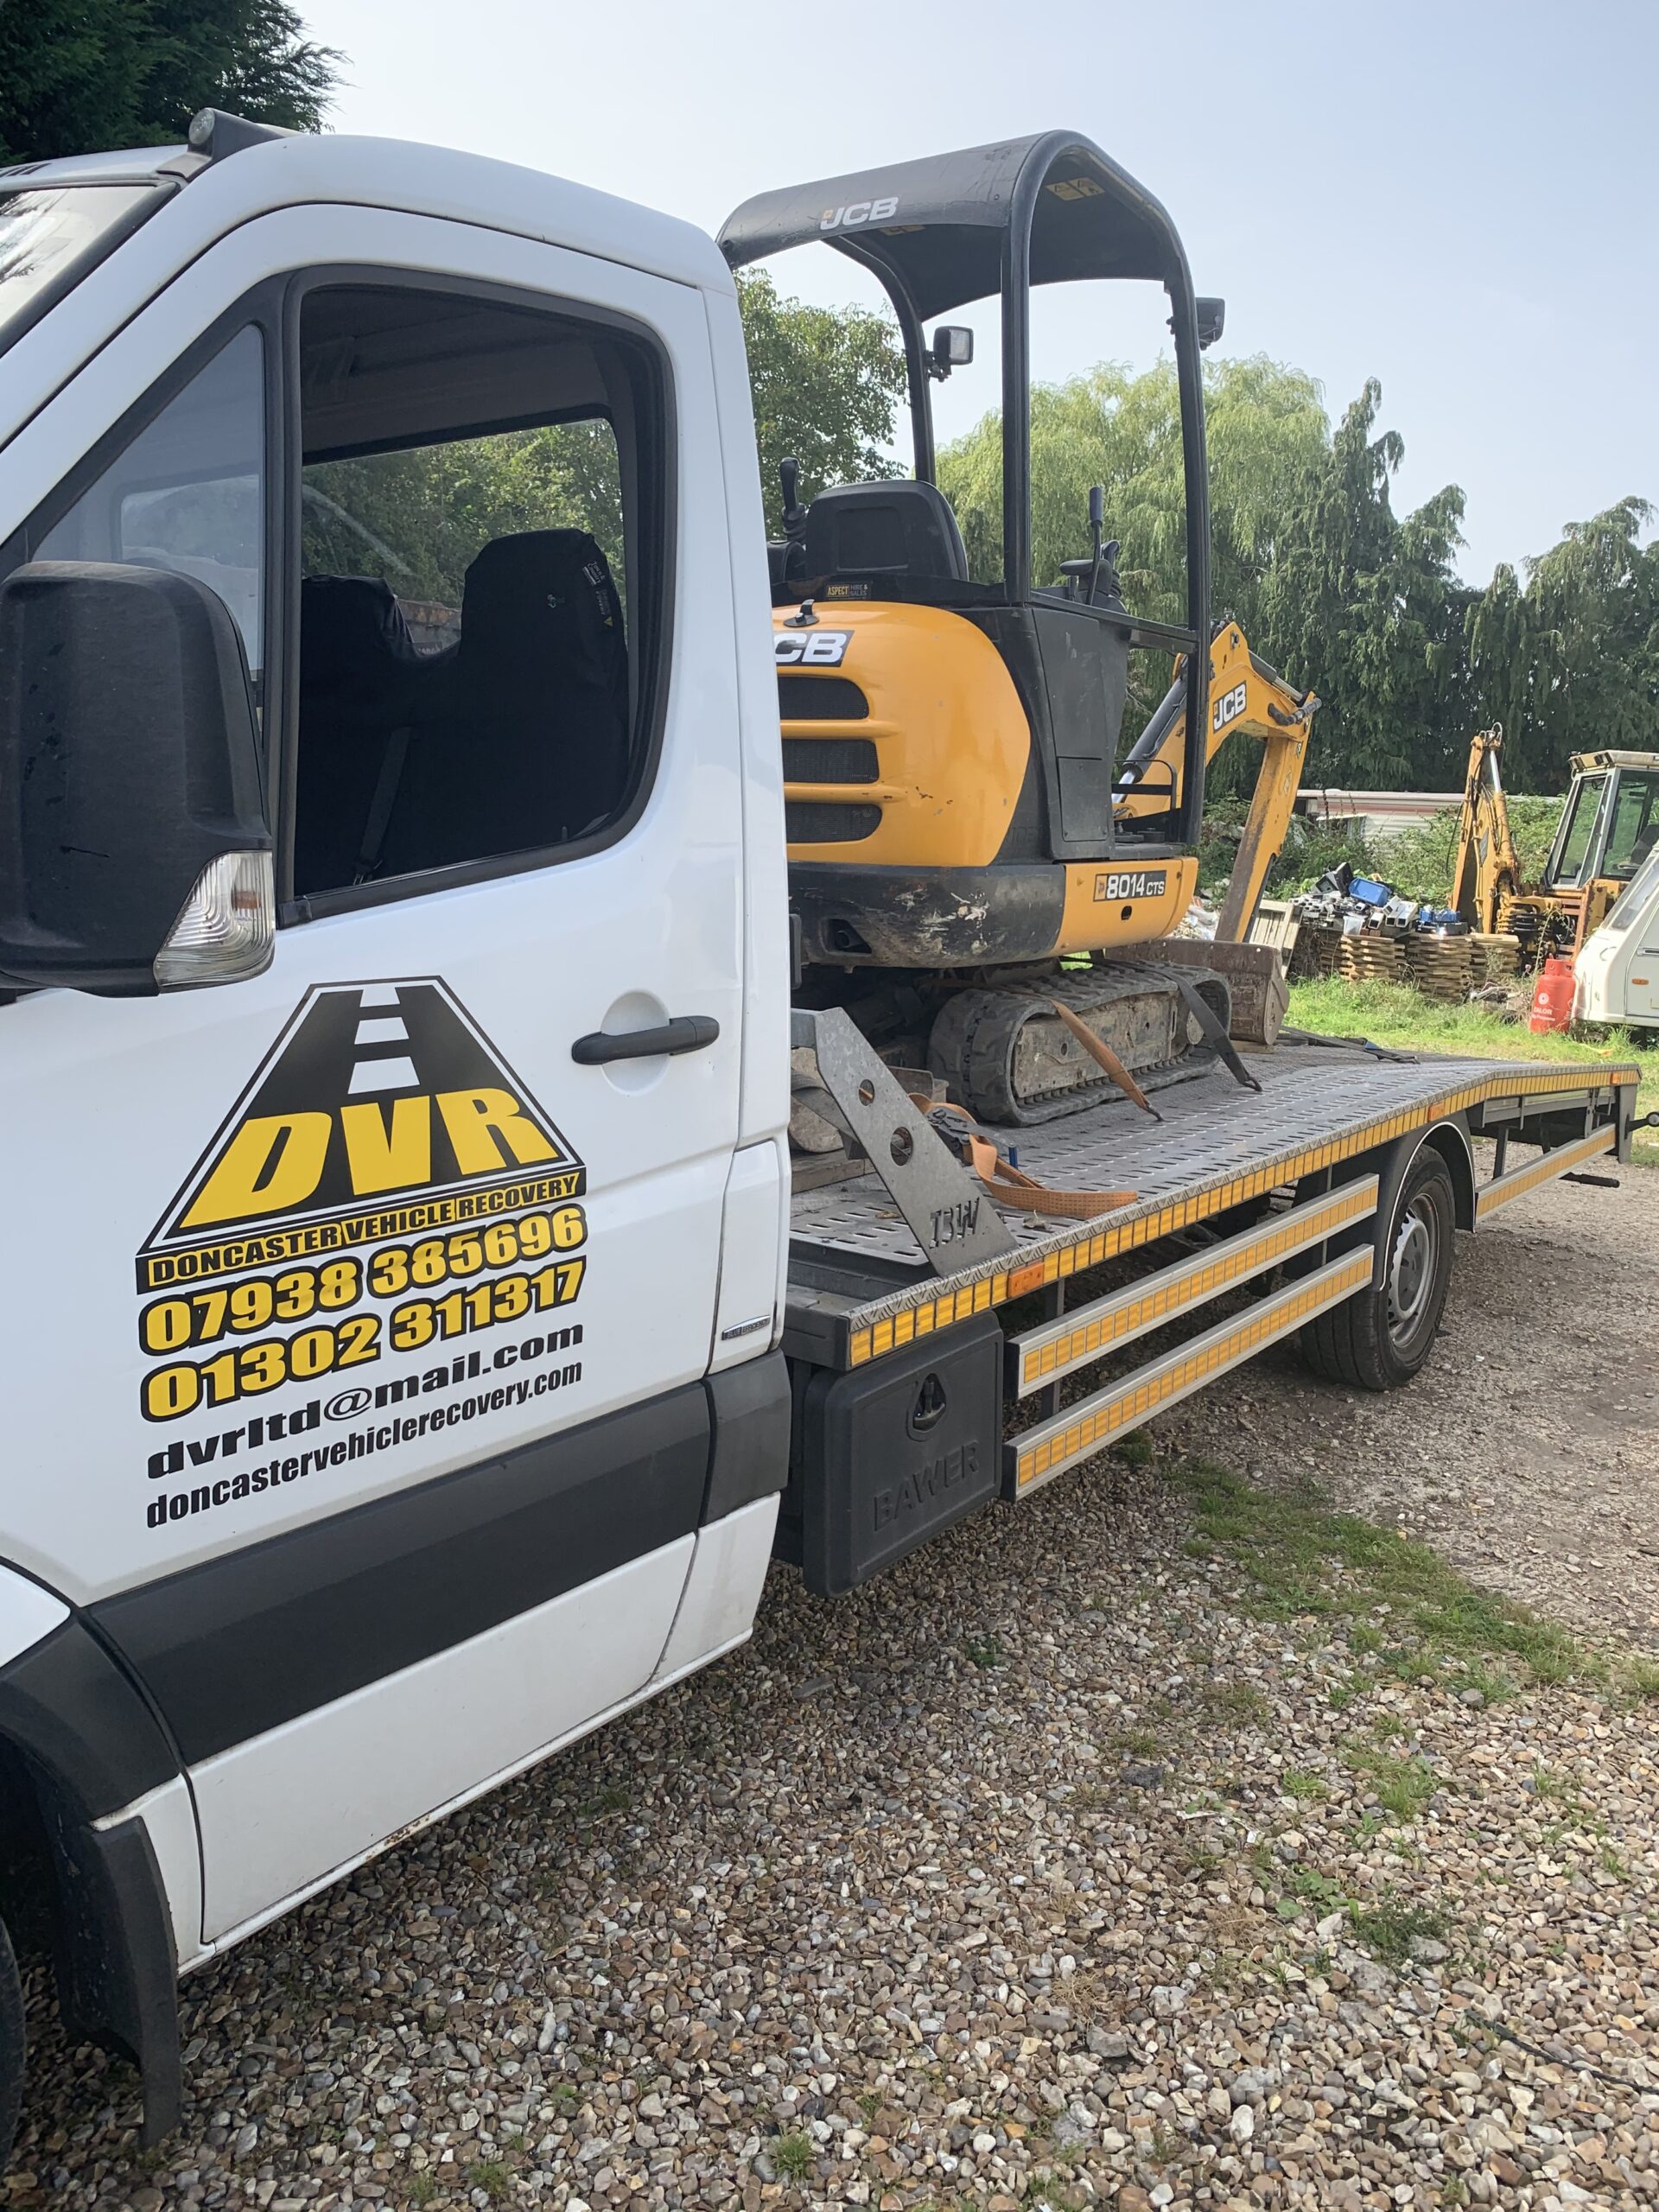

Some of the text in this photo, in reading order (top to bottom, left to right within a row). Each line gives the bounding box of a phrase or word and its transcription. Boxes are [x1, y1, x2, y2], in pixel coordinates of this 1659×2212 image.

[820, 197, 899, 230] JCB
[828, 586, 849, 596] ASPECT
[774, 632, 848, 663] CB
[1213, 683, 1246, 731] JCB
[1107, 874, 1146, 899] 8014
[1146, 881, 1165, 896] CTS
[179, 1087, 560, 1229] DVR
[152, 1175, 577, 1283] DONCASTER VEHICLE RECOVERY
[139, 1203, 588, 1356] 07938 385696
[140, 1255, 588, 1423] 01302 311317
[146, 1361, 583, 1529] doncastervehiclerecovery.com
[147, 1323, 584, 1480] dvrltd@mail.com
[874, 1440, 980, 1532] BAWER
